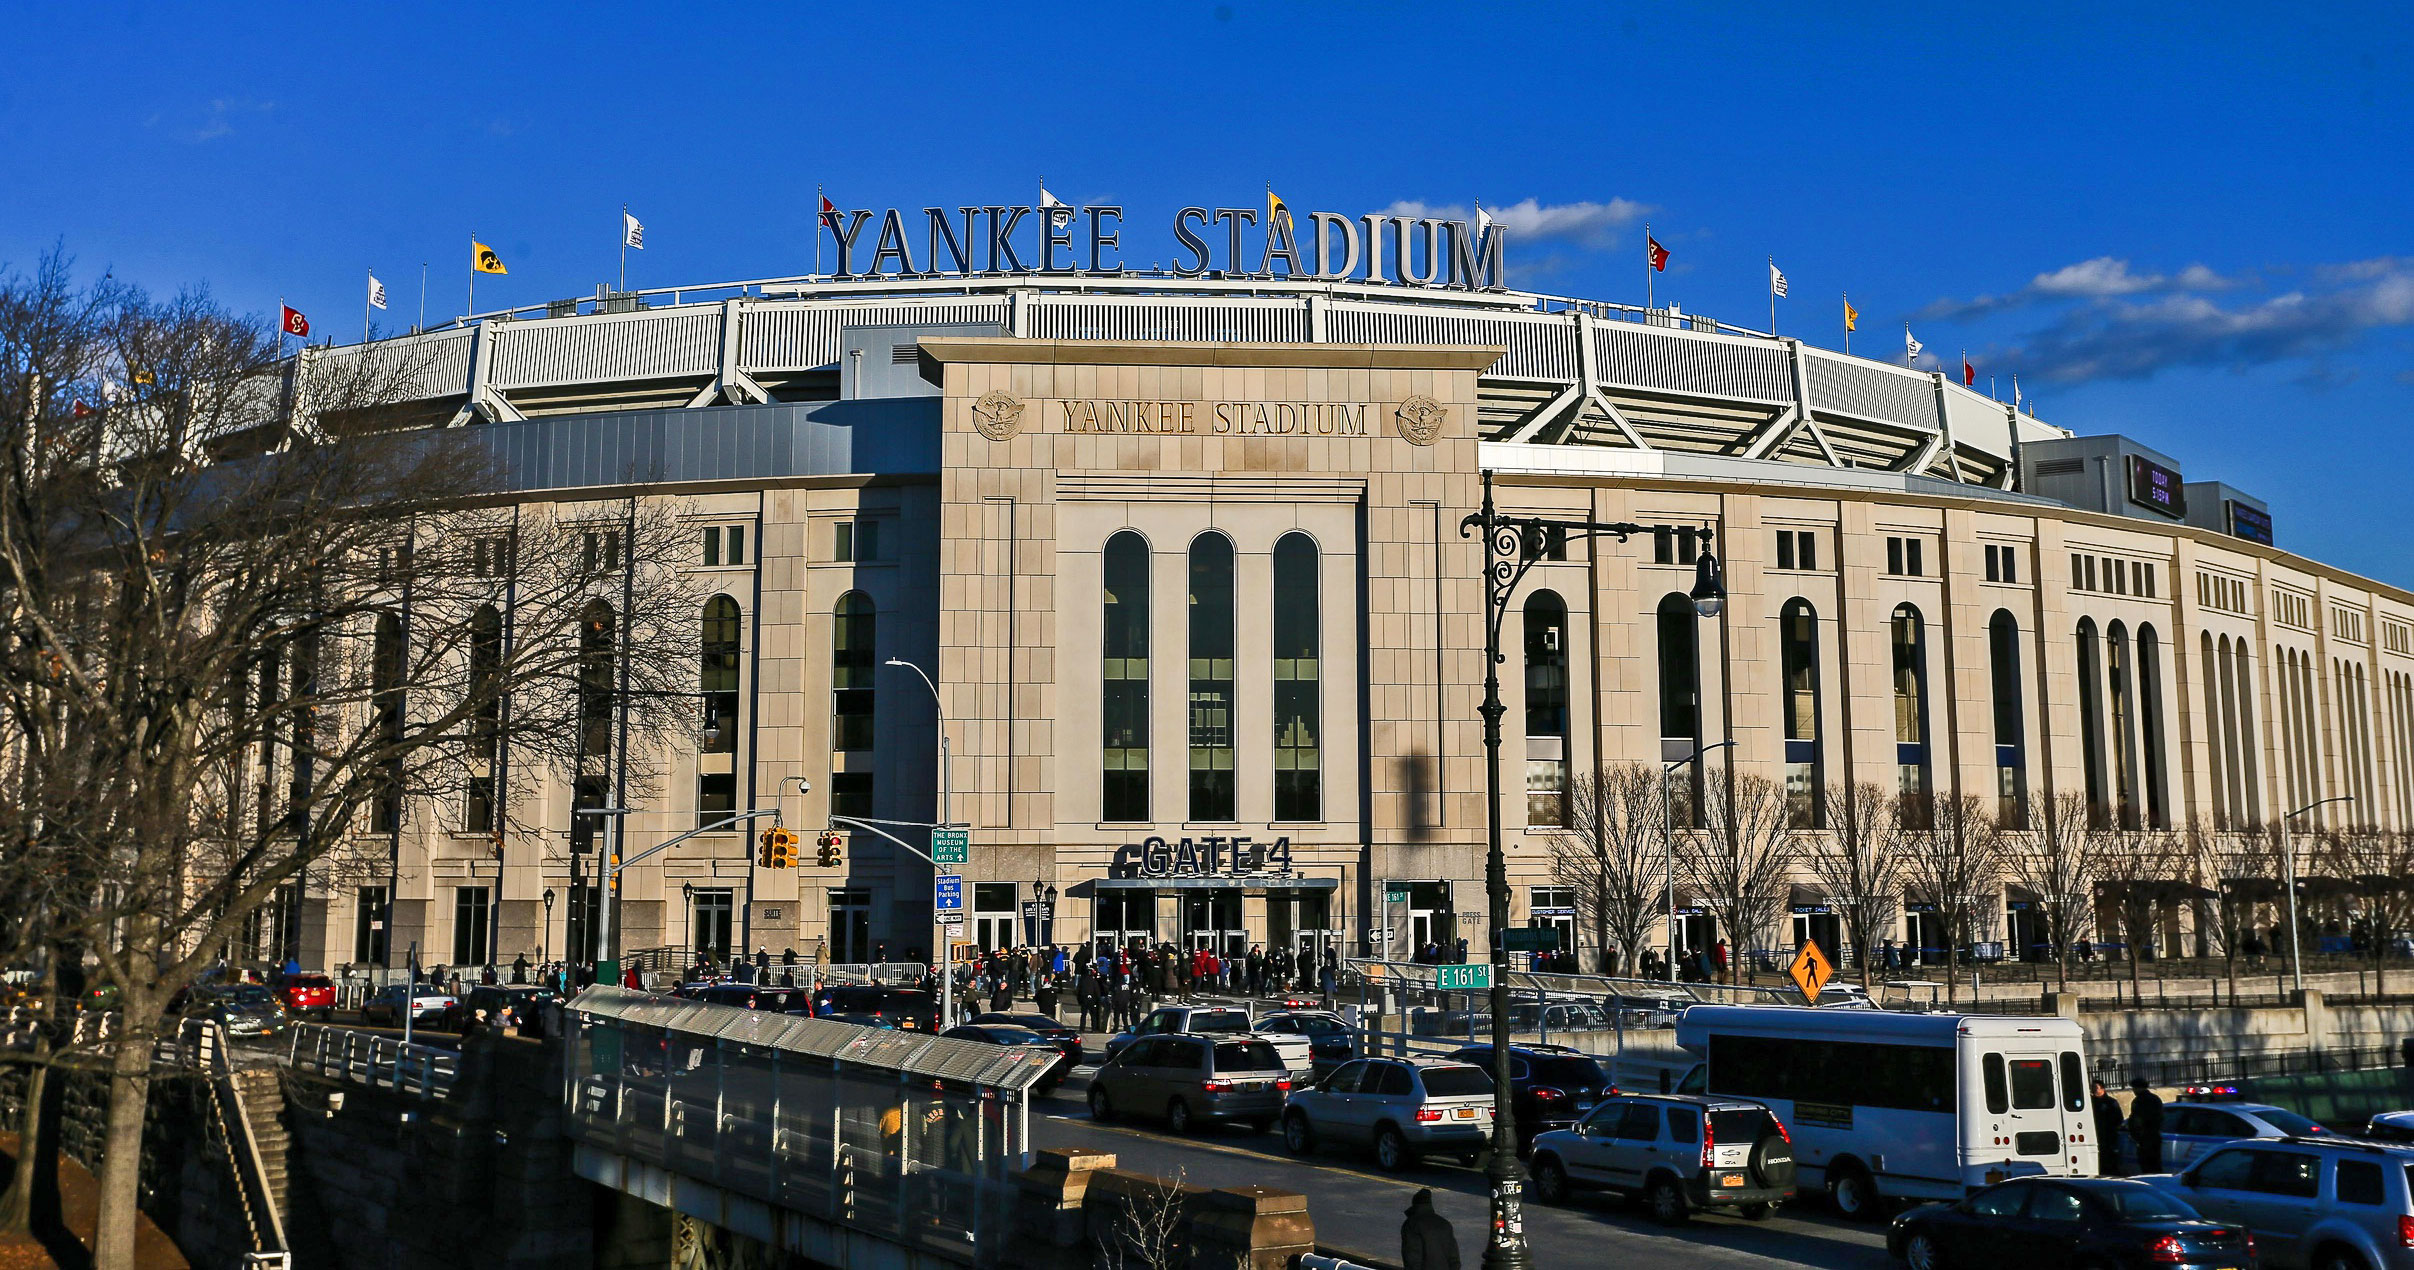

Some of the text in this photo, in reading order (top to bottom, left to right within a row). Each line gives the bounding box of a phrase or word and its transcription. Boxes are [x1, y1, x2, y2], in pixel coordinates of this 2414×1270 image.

[817, 205, 1508, 292] YANKEE STADIUM
[1058, 400, 1368, 436] YANKEE STADIUM
[2152, 470, 2168, 488] TODAY
[1141, 836, 1293, 876] GATE 4
[937, 877, 960, 885] Stadium
[938, 891, 960, 899] Parking
[1441, 965, 1487, 986] E 161 St
[1767, 1156, 1791, 1165] HONDA
